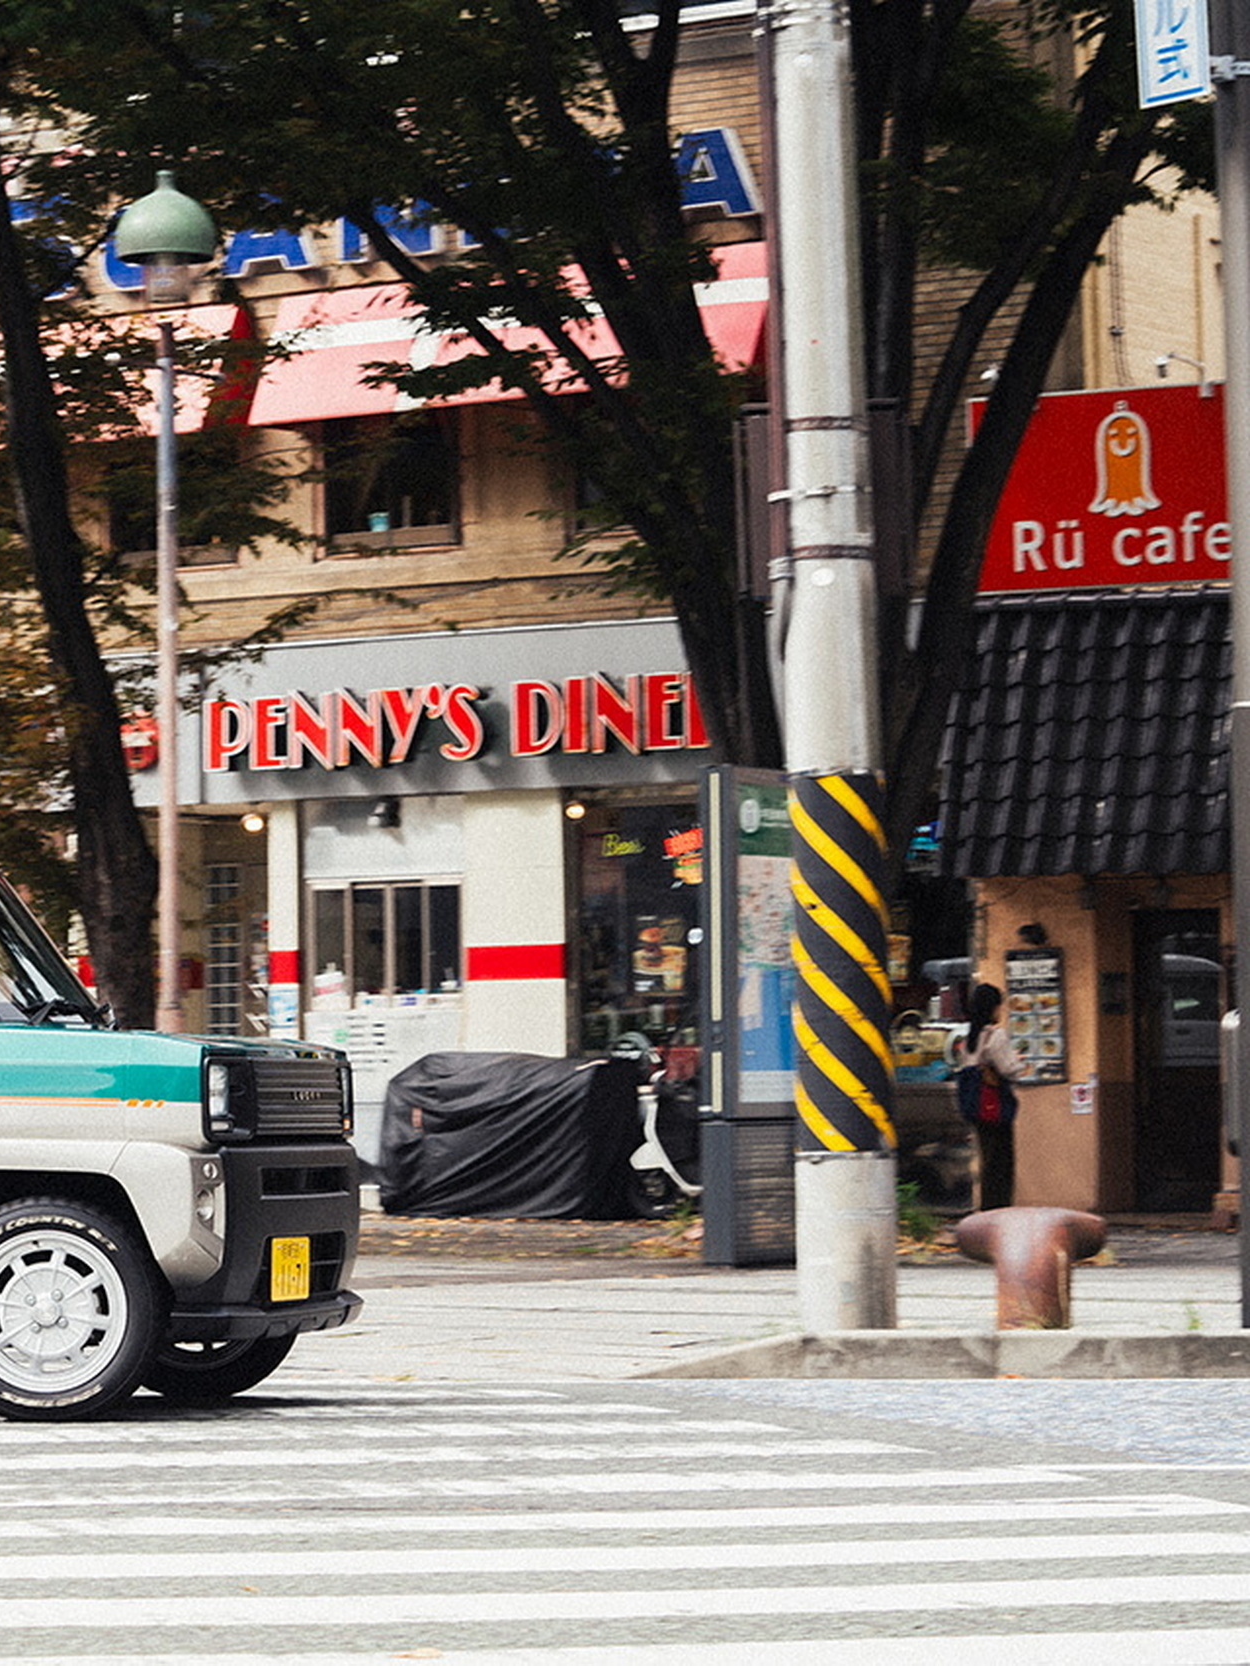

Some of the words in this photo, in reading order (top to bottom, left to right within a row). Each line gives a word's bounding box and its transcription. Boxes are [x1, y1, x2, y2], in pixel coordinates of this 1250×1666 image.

[1012, 519, 1085, 573] Rü
[1112, 511, 1233, 566] cafe
[203, 682, 483, 772] PENNY'S
[4, 1215, 86, 1231] COUNTRY
